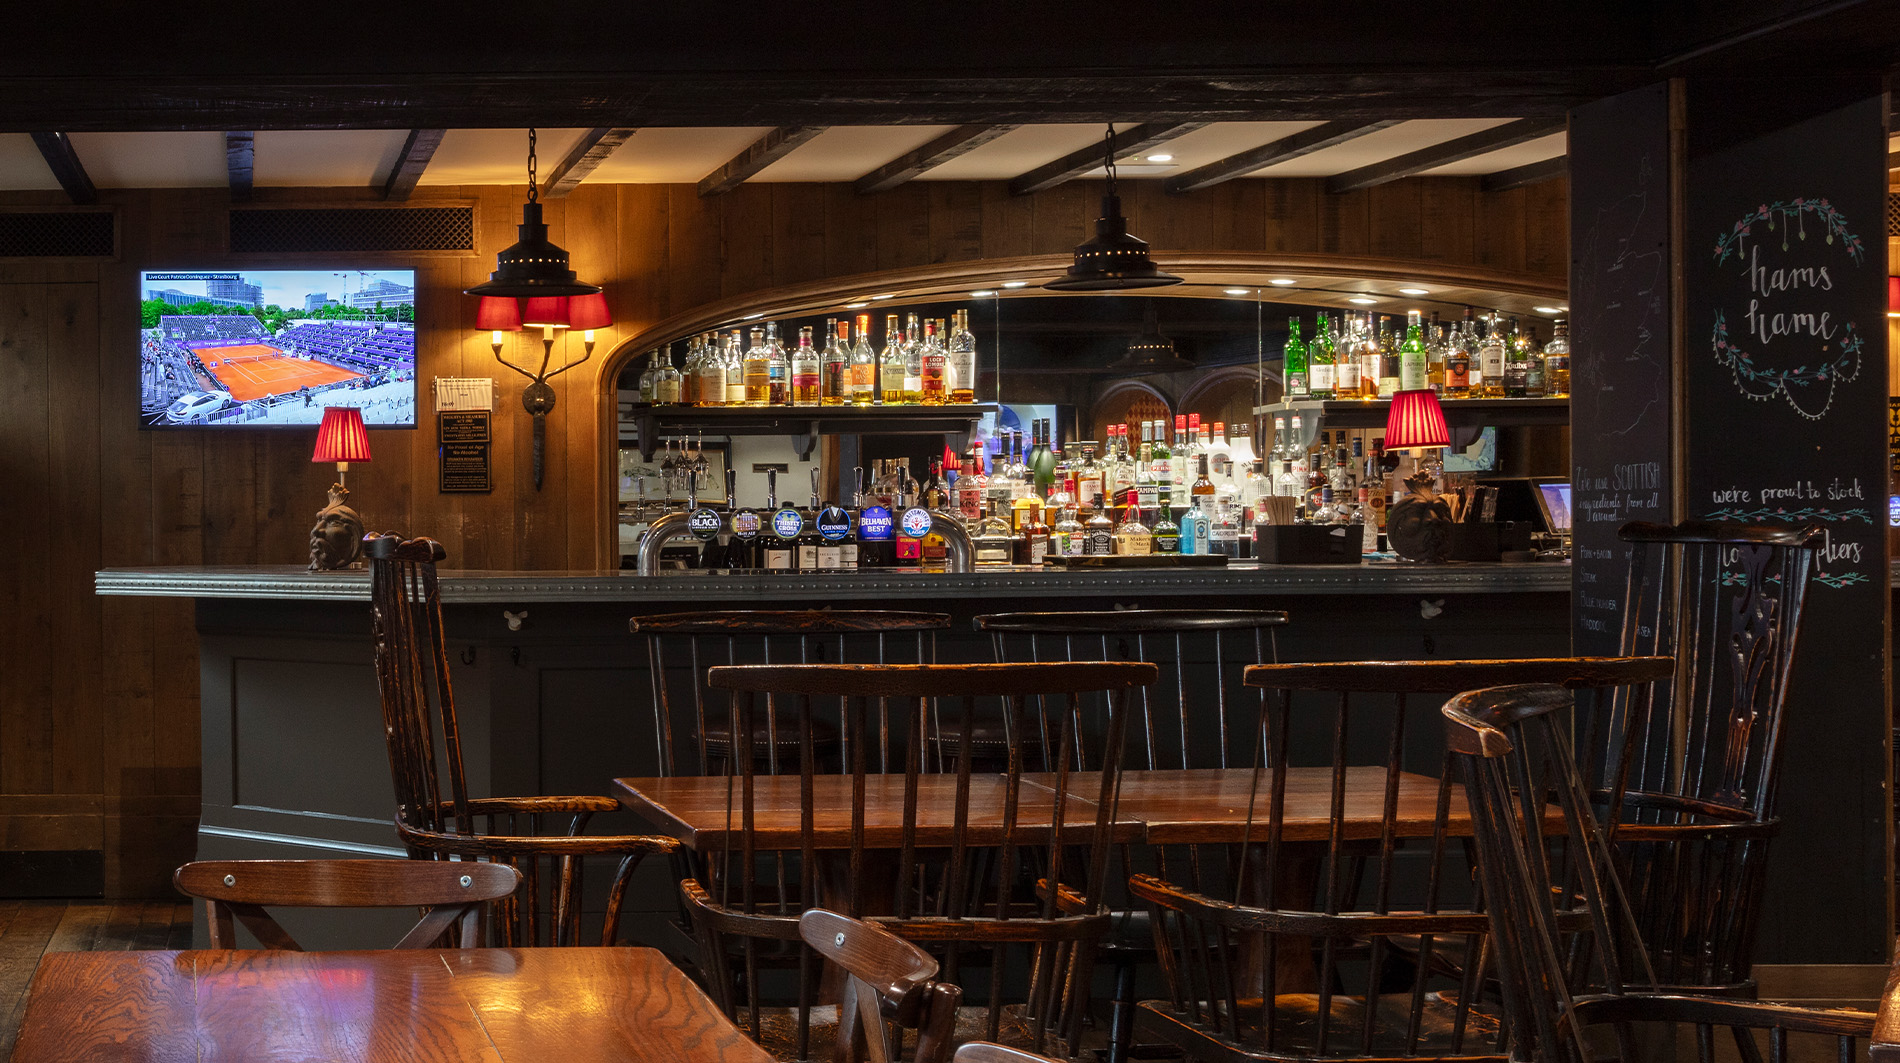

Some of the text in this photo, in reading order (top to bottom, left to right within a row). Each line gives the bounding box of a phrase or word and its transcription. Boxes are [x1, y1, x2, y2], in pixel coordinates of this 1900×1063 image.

[1741, 245, 1833, 297] hams
[1744, 299, 1838, 344] hame
[1613, 462, 1660, 491] SCOTTISH
[1625, 493, 1644, 514] from
[1647, 491, 1659, 509] all
[1713, 478, 1865, 504] we're proud to stock
[692, 518, 718, 526] BLACK
[861, 517, 892, 526] BELHAVEN
[867, 525, 886, 533] BEST
